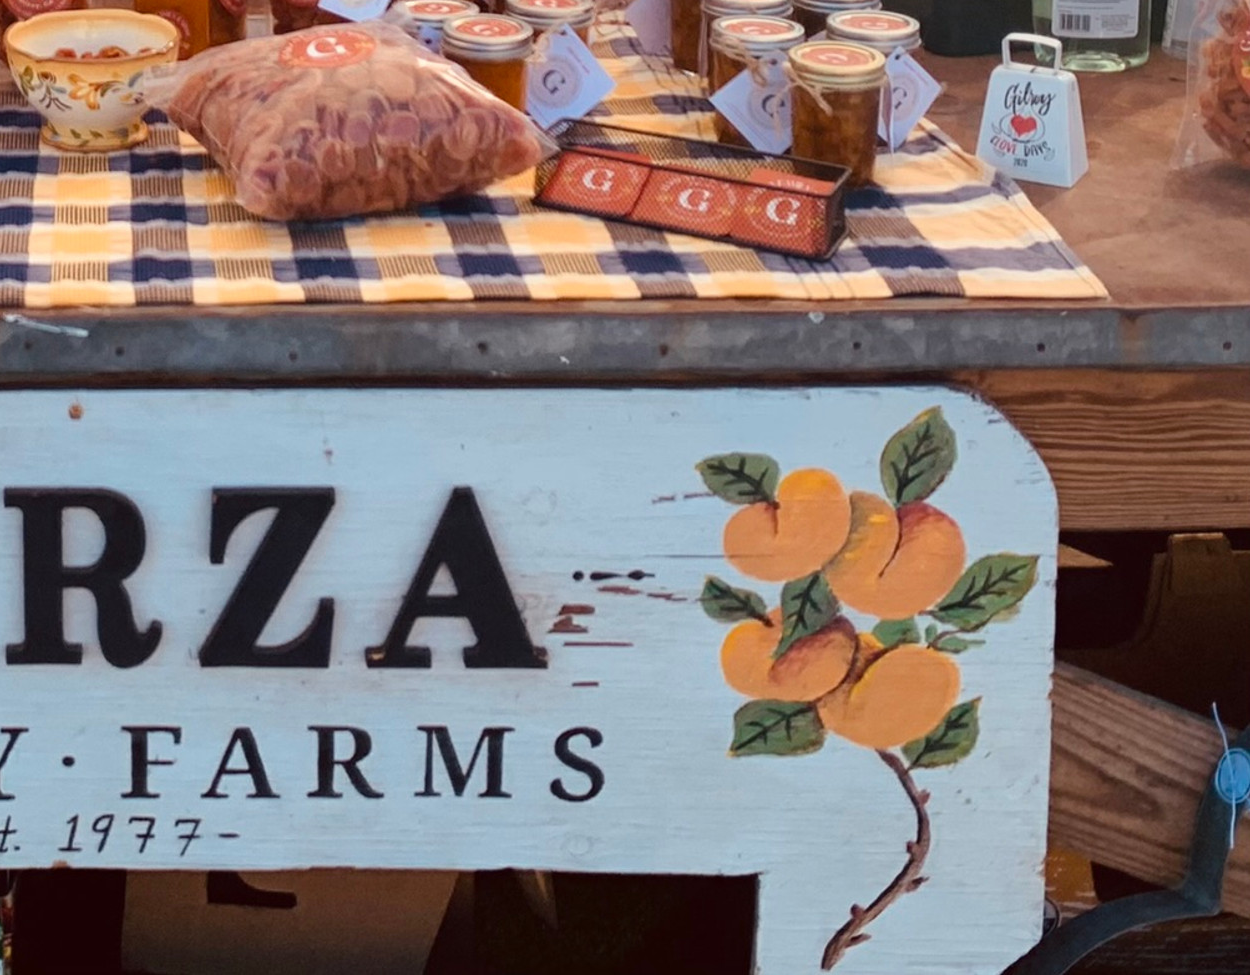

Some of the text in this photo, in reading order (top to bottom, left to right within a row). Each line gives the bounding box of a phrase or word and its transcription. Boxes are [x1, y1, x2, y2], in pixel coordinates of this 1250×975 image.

[1004, 81, 1056, 116] Gilroy
[1024, 141, 1051, 157] DAYS
[582, 169, 615, 192] G
[677, 188, 711, 213] G
[765, 197, 801, 225] G
[120, 726, 605, 803] FARMS
[57, 814, 202, 856] 1977
